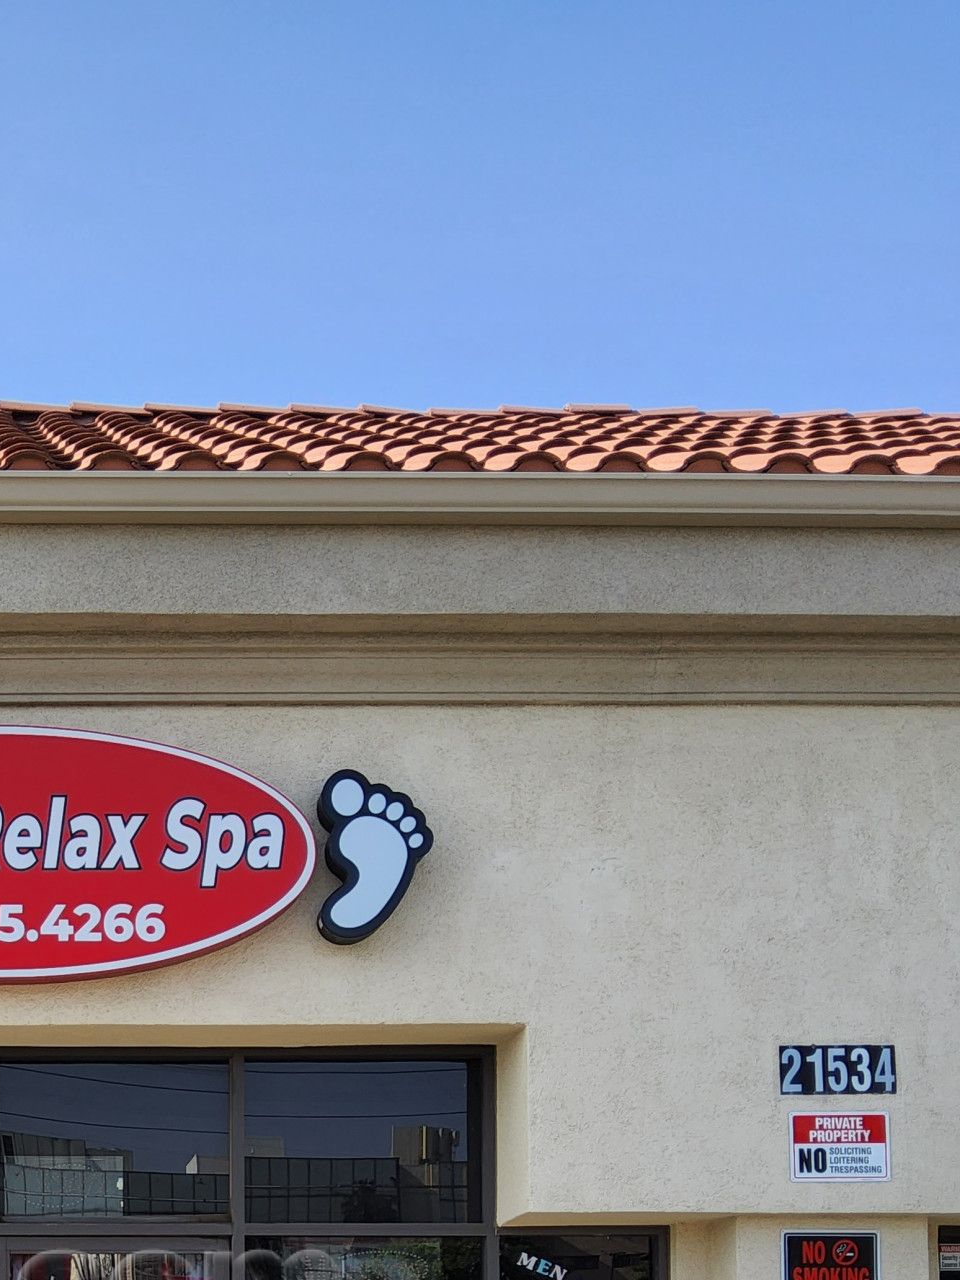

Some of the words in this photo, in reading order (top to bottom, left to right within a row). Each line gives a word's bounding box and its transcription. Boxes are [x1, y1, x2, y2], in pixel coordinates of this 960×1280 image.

[160, 797, 285, 888] Spa
[781, 1047, 896, 1093] 21534
[815, 1117, 863, 1129] PRIVATE
[809, 1130, 871, 1143] PROPERTY
[829, 1147, 872, 1155] SOLICITING
[798, 1147, 827, 1174] NO
[829, 1156, 869, 1164] LOITERING
[829, 1165, 882, 1174] TRESPASSING
[802, 1240, 826, 1264] NO
